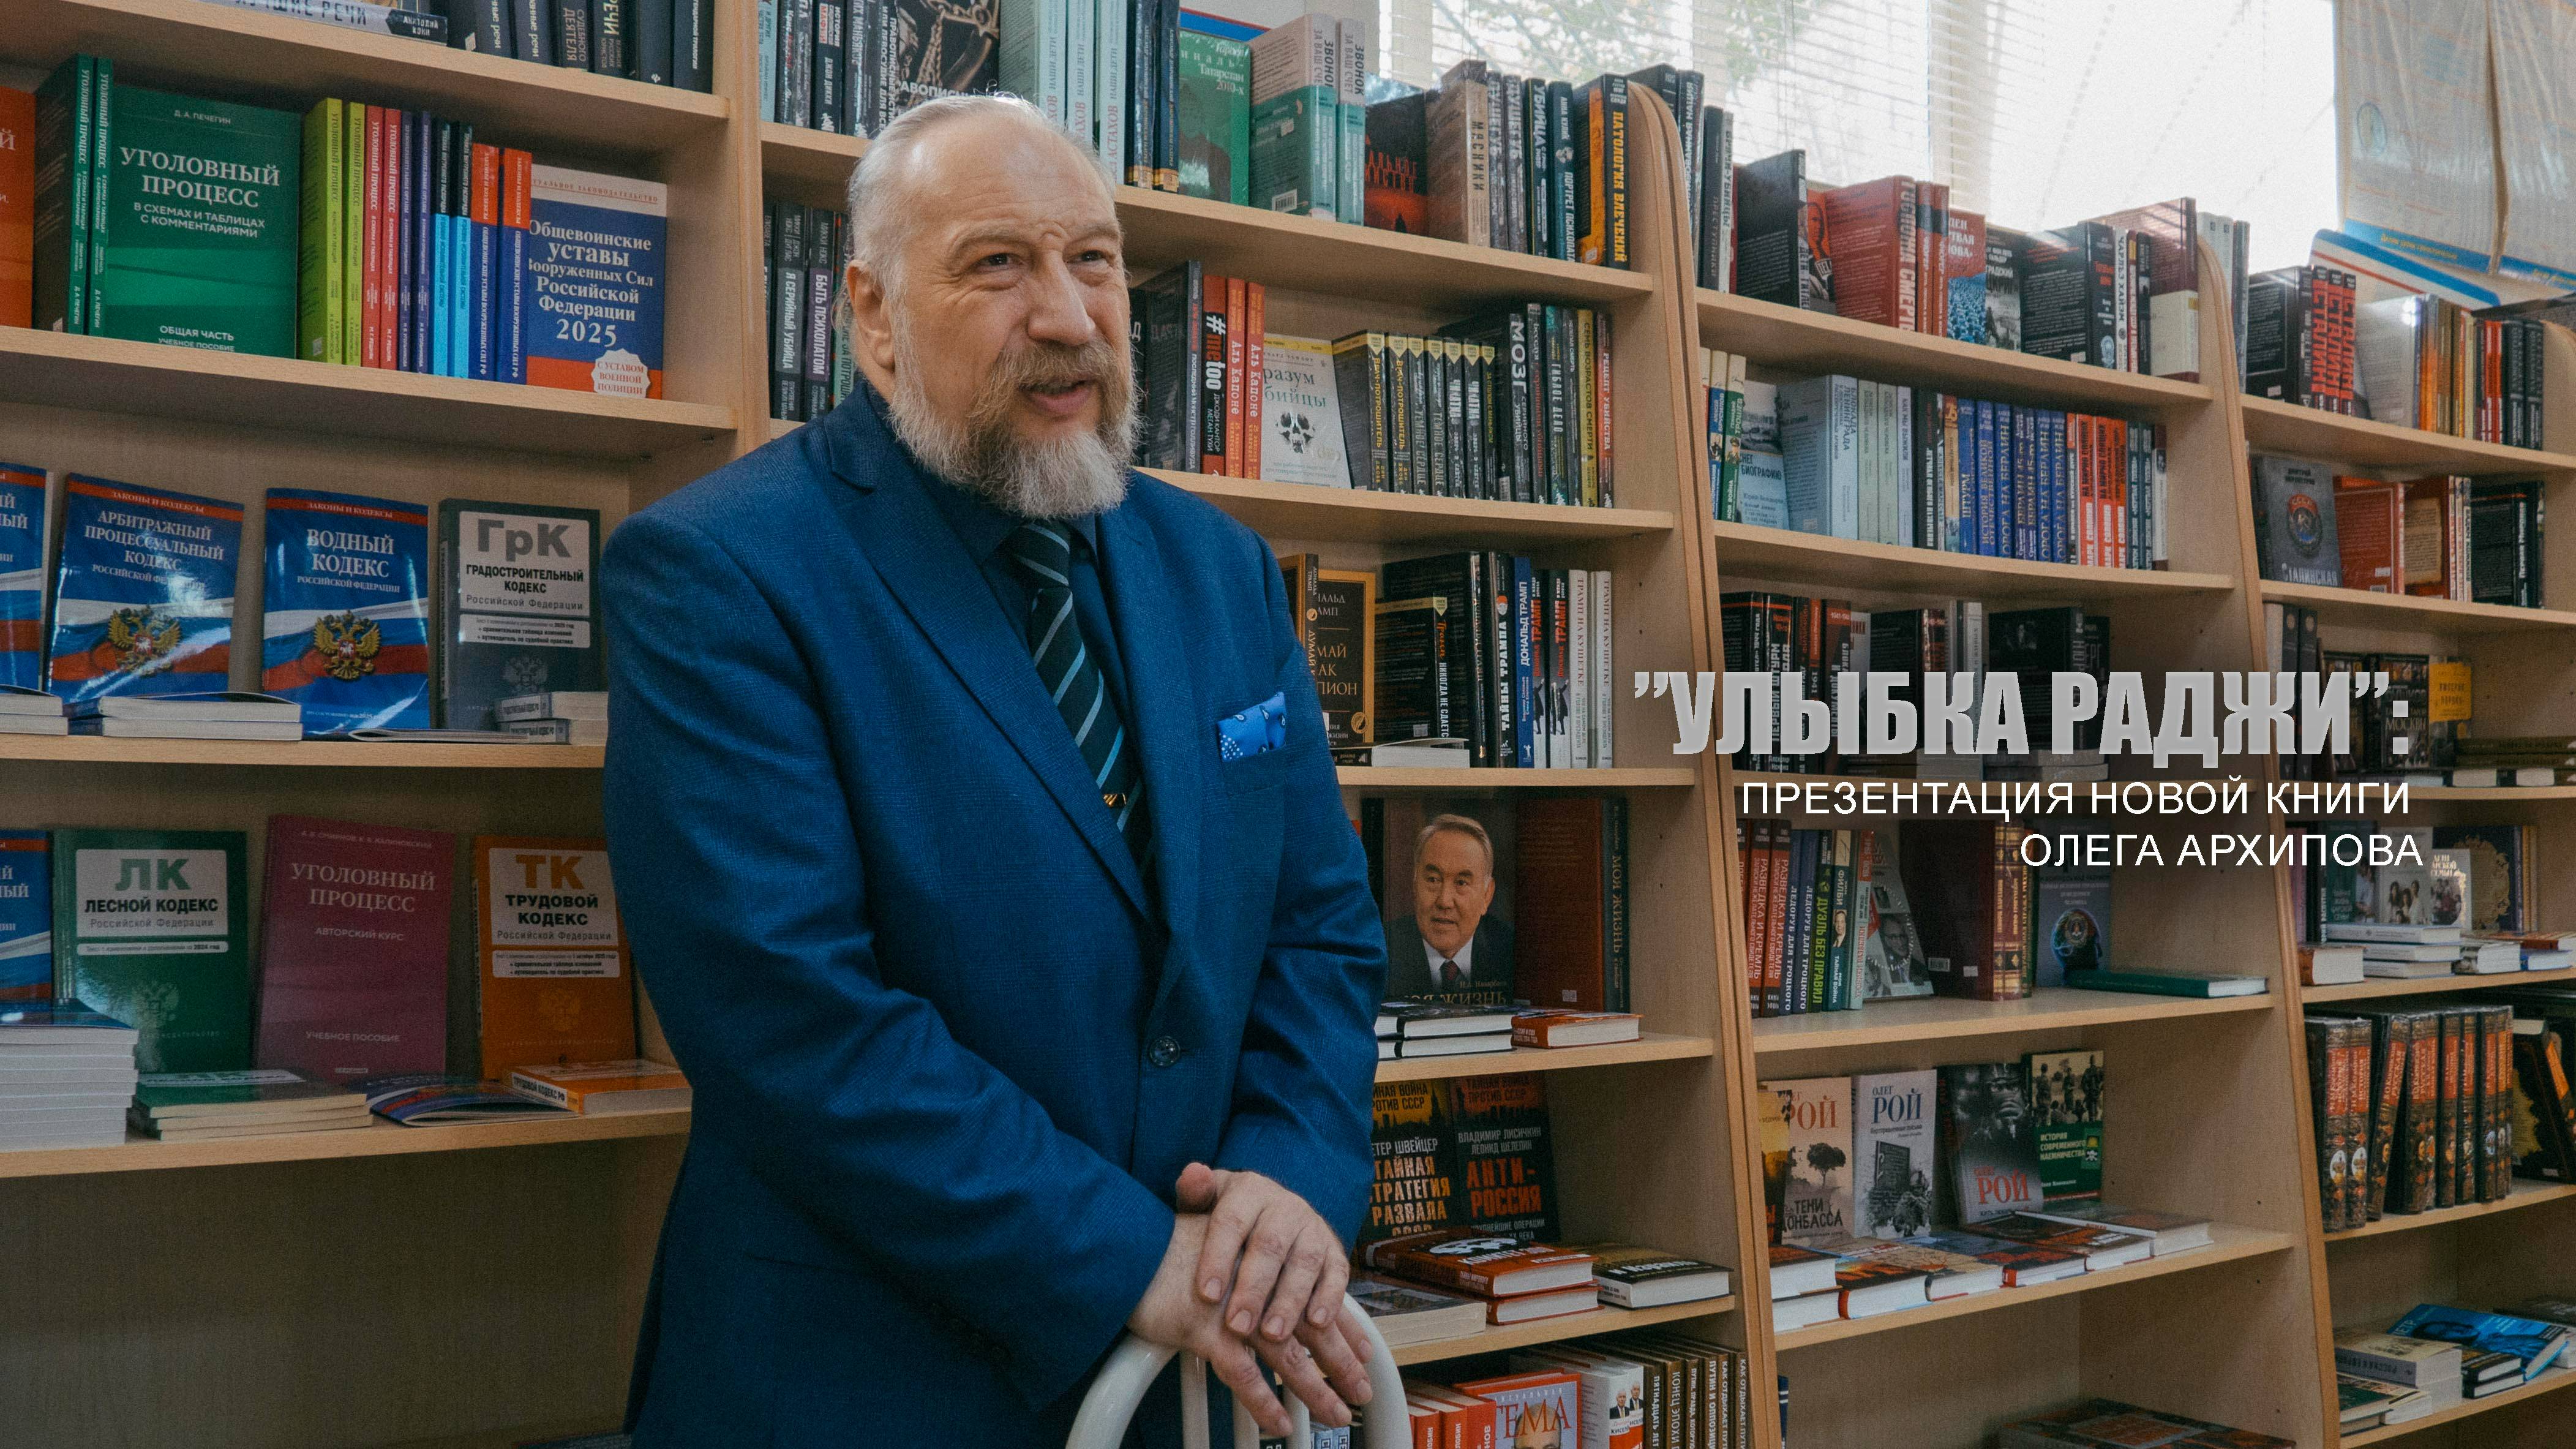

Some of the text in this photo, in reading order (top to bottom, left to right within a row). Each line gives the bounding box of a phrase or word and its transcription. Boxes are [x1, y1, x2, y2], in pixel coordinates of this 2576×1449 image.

[322, 1, 366, 25] РЕЧИ
[563, 7, 577, 61] ДЕЯТЕЛЯ
[576, 9, 586, 62] СУДЕБНОГО
[824, 57, 833, 78] ДЖОН
[1200, 64, 1245, 84] Татарстан
[1354, 45, 1364, 96] ЗВОНОК
[98, 73, 110, 168] УГОЛОВНЫЙ ПРОЦЕСС
[1107, 105, 1118, 159] АСТАХОВ
[1507, 83, 1522, 160] ДУШЕГУБ
[1533, 85, 1547, 146] УБИЙЦА
[119, 146, 280, 187] УГОЛОВНЫЙ
[1471, 121, 1484, 190] МЯСНИКИ
[141, 175, 260, 209] ПРОЦЕСС
[1612, 111, 1627, 262] ПАТОЛОГИЯ ВЛЕЧЕНИЙ
[133, 202, 266, 229] В СХЕМАХ И ТАБЛИЦАХ
[140, 214, 258, 238] С КОММЕНТАРИЯМИ
[1564, 172, 1575, 262] ПОРТРЕТ ПСИХОПАТА
[528, 219, 652, 252] Общевоинские
[547, 242, 629, 268] уставы
[535, 274, 640, 305] Российской
[625, 270, 653, 287] Сил
[538, 295, 636, 322] Федерации
[784, 280, 797, 330] СЕРИЙНЫЙ
[159, 325, 234, 342] ОБЩАЯ ЧАСТЬ
[555, 318, 618, 348] 2025
[812, 274, 828, 375] БЫТЬ ПСИХОПАТОМ
[2313, 291, 2327, 382] СТАЛИН
[2327, 295, 2342, 385] СТАЛИН
[782, 332, 795, 369] УБИЙЦА
[1206, 315, 1226, 390] #metoo
[1231, 341, 1242, 364] Аль
[1510, 321, 1526, 394] МОЗГ
[2342, 299, 2355, 388] СТАЛИН
[597, 382, 643, 396] ПОЛИЦИИ
[598, 372, 642, 385] ВОЕННОЙ
[1231, 367, 1241, 414] Капоне
[1263, 368, 1315, 388] разум
[1551, 363, 1563, 432] ГИБЛОЕ ДЕЛО
[1514, 404, 1522, 442] УБИЙЦЫ
[1520, 396, 1529, 451] СЕРИЙНОГО
[1741, 465, 1782, 481] БИОГРАФИЮ
[2040, 431, 2049, 510] НА БЕРЛИН
[1962, 473, 1972, 518] ШТУРМ
[1979, 439, 1989, 544] ИСТОРИЯ ВЕЛИКОЙ
[97, 510, 212, 541] АРБИТРАЖНЫЙ
[307, 528, 395, 555] ВОДНЫЙ
[477, 518, 571, 562] ГрК
[84, 525, 224, 561] ПРОЦЕССУАЛЬНЫЙ
[92, 564, 151, 582] РОССИЙСКОЙ
[124, 549, 182, 572] КОДЕКС
[311, 552, 389, 578] КОДЕКС
[466, 563, 584, 582] ГРАДОСТРОИТЕЛЬНЫЙ
[297, 576, 400, 593] РОССИЙСКОЙ ФЕДЕРАЦИИ
[504, 580, 547, 594] КОДЕКС
[466, 594, 584, 611] Российской Федерации
[1519, 581, 1530, 666] ДОНАЛЬД ТРАМП
[1498, 621, 1510, 731] ТАЙНЫ ТРАМПА
[115, 858, 192, 892] ЛК
[291, 862, 435, 892] УГОЛОВНЫЙ
[516, 854, 584, 891] ТК
[1836, 870, 1844, 906] ФИЛБИ
[84, 895, 218, 914] ЛЕСНОЙ КОДЕКС
[309, 889, 416, 914] ПРОЦЕСС
[505, 892, 599, 909] ТРУДОВОЙ
[1611, 855, 1623, 954] МОЯ ЖИЗНЬ
[1803, 886, 1814, 932] ЛЕДОРУБ
[315, 925, 404, 942] АВТОРСКИЙ КУРС
[518, 911, 588, 927] КОДЕКС
[1774, 859, 1789, 979] РАЗВЕДКА И КРЕМЛЬ
[1812, 897, 1828, 1004] ДУЭЛЬ БЕЗ ПРАВИЛ
[1800, 958, 1809, 1010] ТРОЦКОГО
[1399, 1083, 1428, 1096] ВОЙНА
[1872, 1085, 1894, 1097] ОЛЕГ
[1873, 1088, 1923, 1124] РОЙ
[1458, 1126, 1541, 1143] ВЛАДИМИР ЛИСИЧКИН
[1471, 1140, 1532, 1156] ЛЕОНИД ШЕЛЕПИН
[2040, 1139, 2087, 1152] СОВРЕМЕННОГО
[1374, 1156, 1435, 1181] ТАЙНАЯ
[2040, 1150, 2086, 1162] НАЕМНИЧЕСТВА
[1370, 1176, 1451, 1203] ТРАТЕГИЯ
[1466, 1157, 1536, 1189] АНТИ-
[1976, 1167, 2030, 1205] РОЙ
[1372, 1200, 1448, 1227] РАЗВАЛА
[1470, 1185, 1542, 1219] РОССИЯ
[1794, 1197, 1823, 1215] ТЕНИ
[1514, 1218, 1545, 1231] ОПЕРАЦИИ
[1651, 1376, 1661, 1429] ПЯТНАДЦАТЬ
[1670, 1371, 1680, 1406] КОНЕЦ
